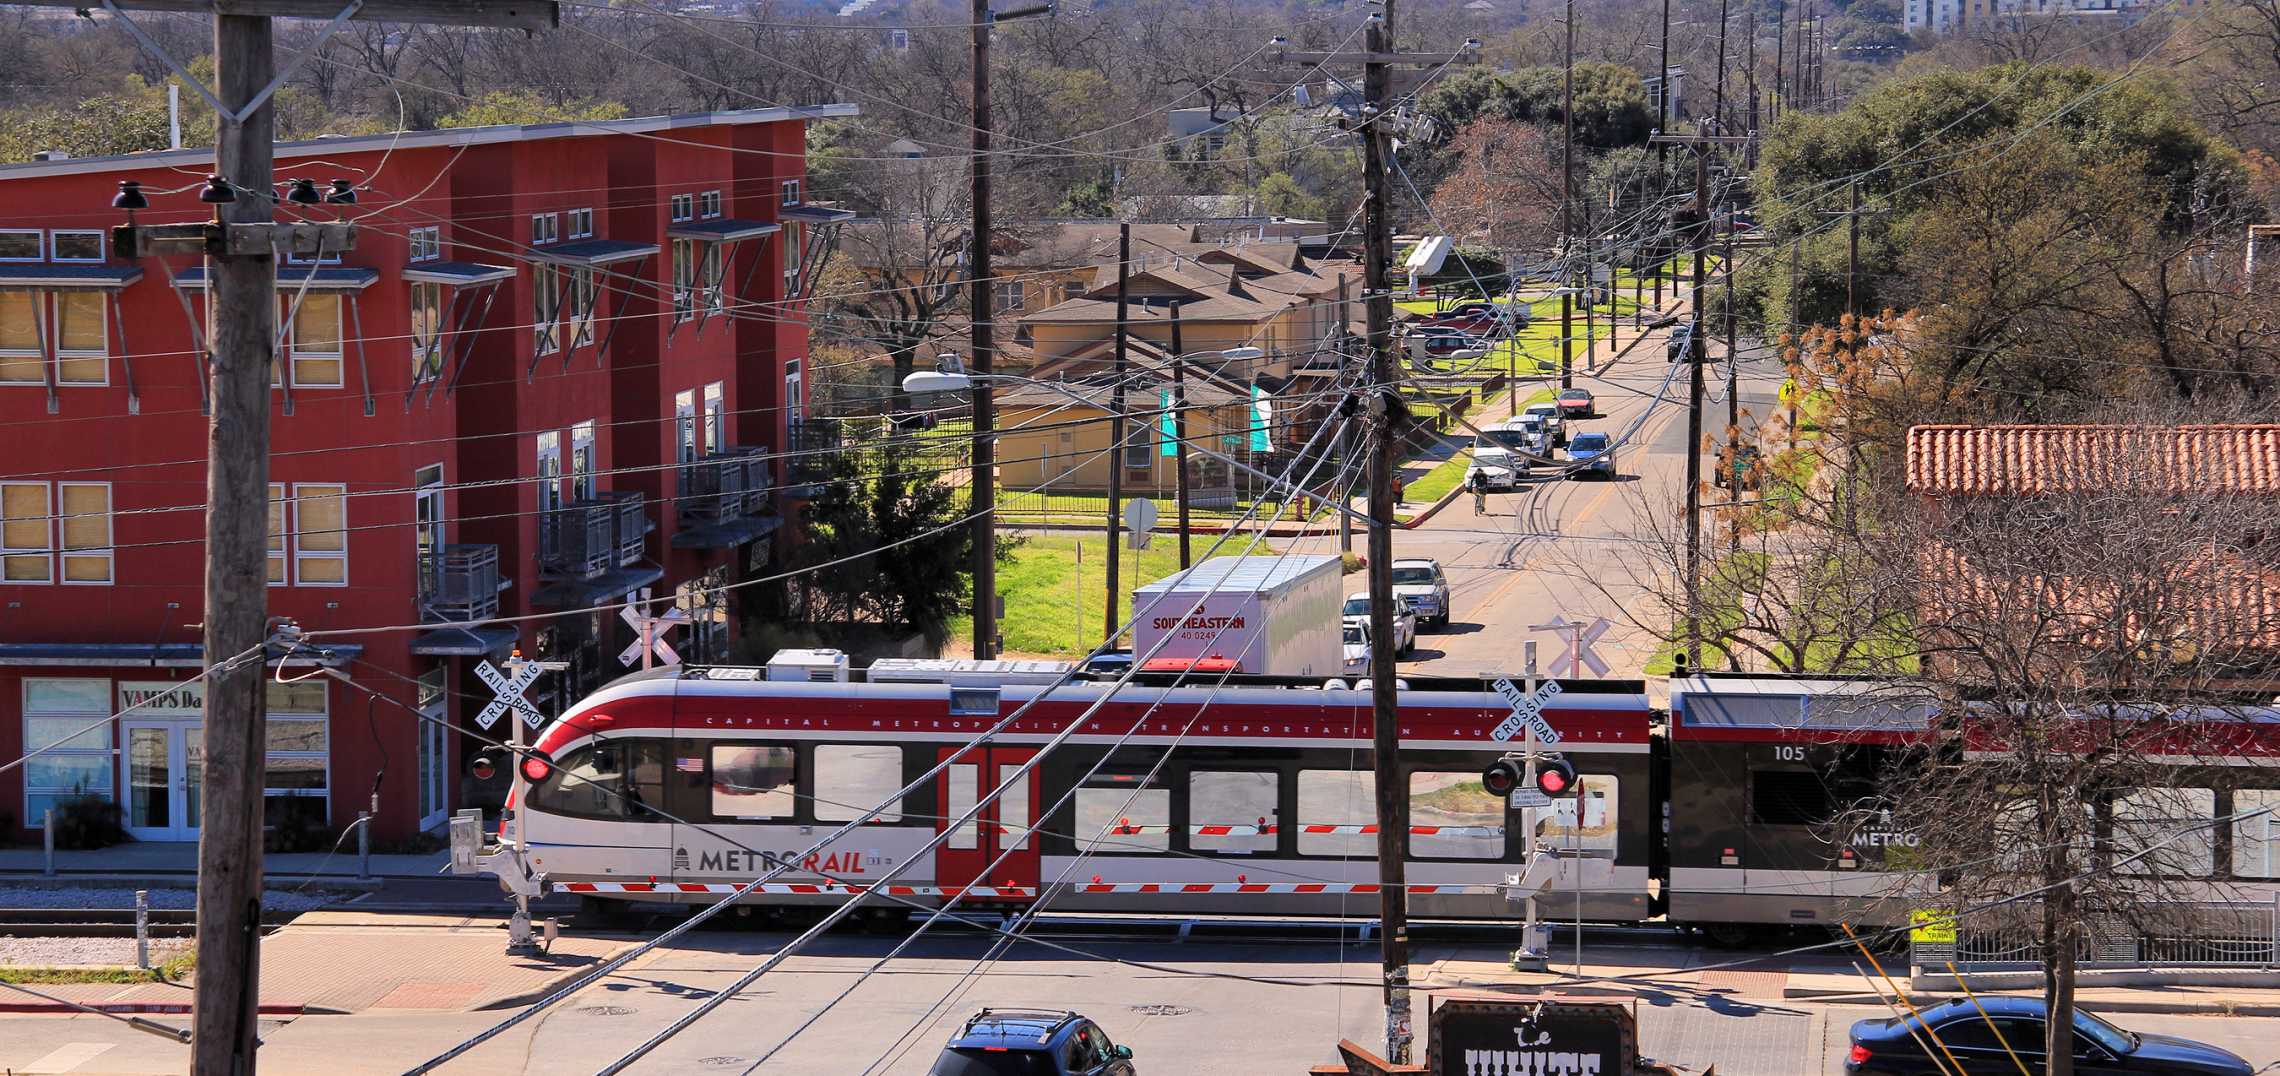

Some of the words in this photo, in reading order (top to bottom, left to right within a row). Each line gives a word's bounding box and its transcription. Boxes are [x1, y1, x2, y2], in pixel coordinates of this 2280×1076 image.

[122, 690, 178, 708] VAMPS
[478, 663, 504, 692] RAIL
[512, 697, 540, 725] ROAD
[480, 664, 538, 725] CROSSING
[1495, 678, 1524, 709] RAIL
[1527, 715, 1556, 744] ROAD
[1495, 683, 1558, 741] CROSSING
[705, 717, 829, 727] CAPITAL
[872, 720, 1100, 730] METROPLITN
[1142, 724, 1410, 736] TRANSPORTATIN
[1775, 746, 1805, 760] 105
[1852, 832, 1920, 847] METRO
